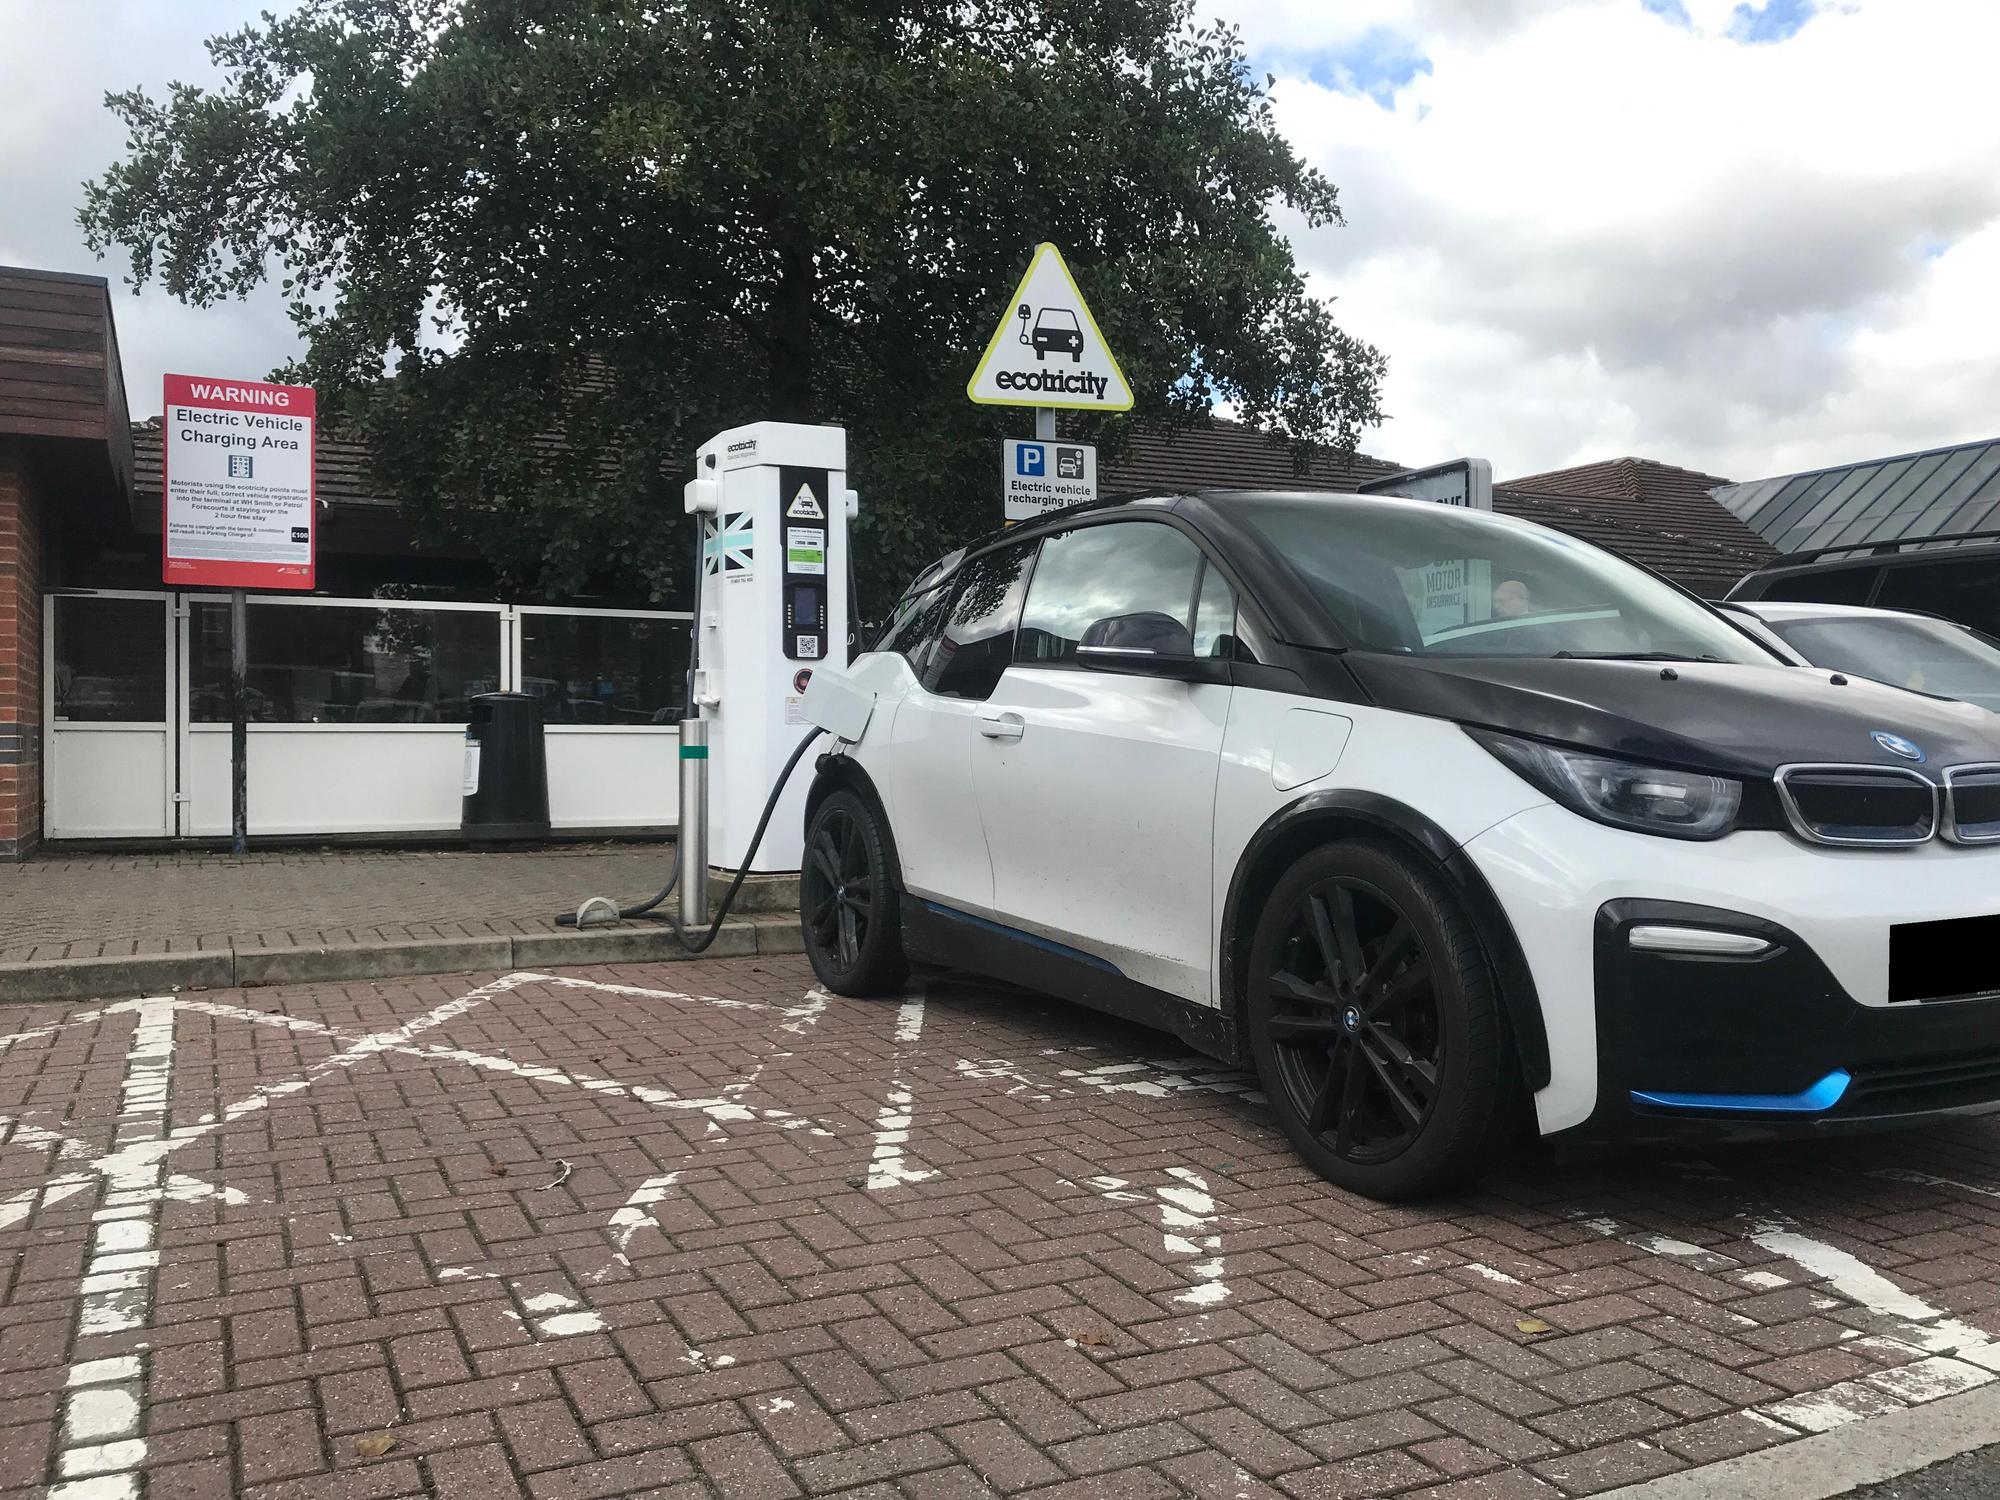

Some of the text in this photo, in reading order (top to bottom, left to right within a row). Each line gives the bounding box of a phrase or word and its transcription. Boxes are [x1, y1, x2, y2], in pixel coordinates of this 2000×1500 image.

[190, 384, 289, 406] WARNING
[996, 368, 1108, 400] ecotricity
[176, 408, 302, 431] Electric Vehicle
[181, 430, 298, 450] Charging Area
[1024, 448, 1040, 472] P
[1012, 480, 1091, 495] Electric vehicle
[204, 496, 231, 504] terminal
[1008, 494, 1064, 507] recharging
[1426, 568, 1461, 592] MOTOR
